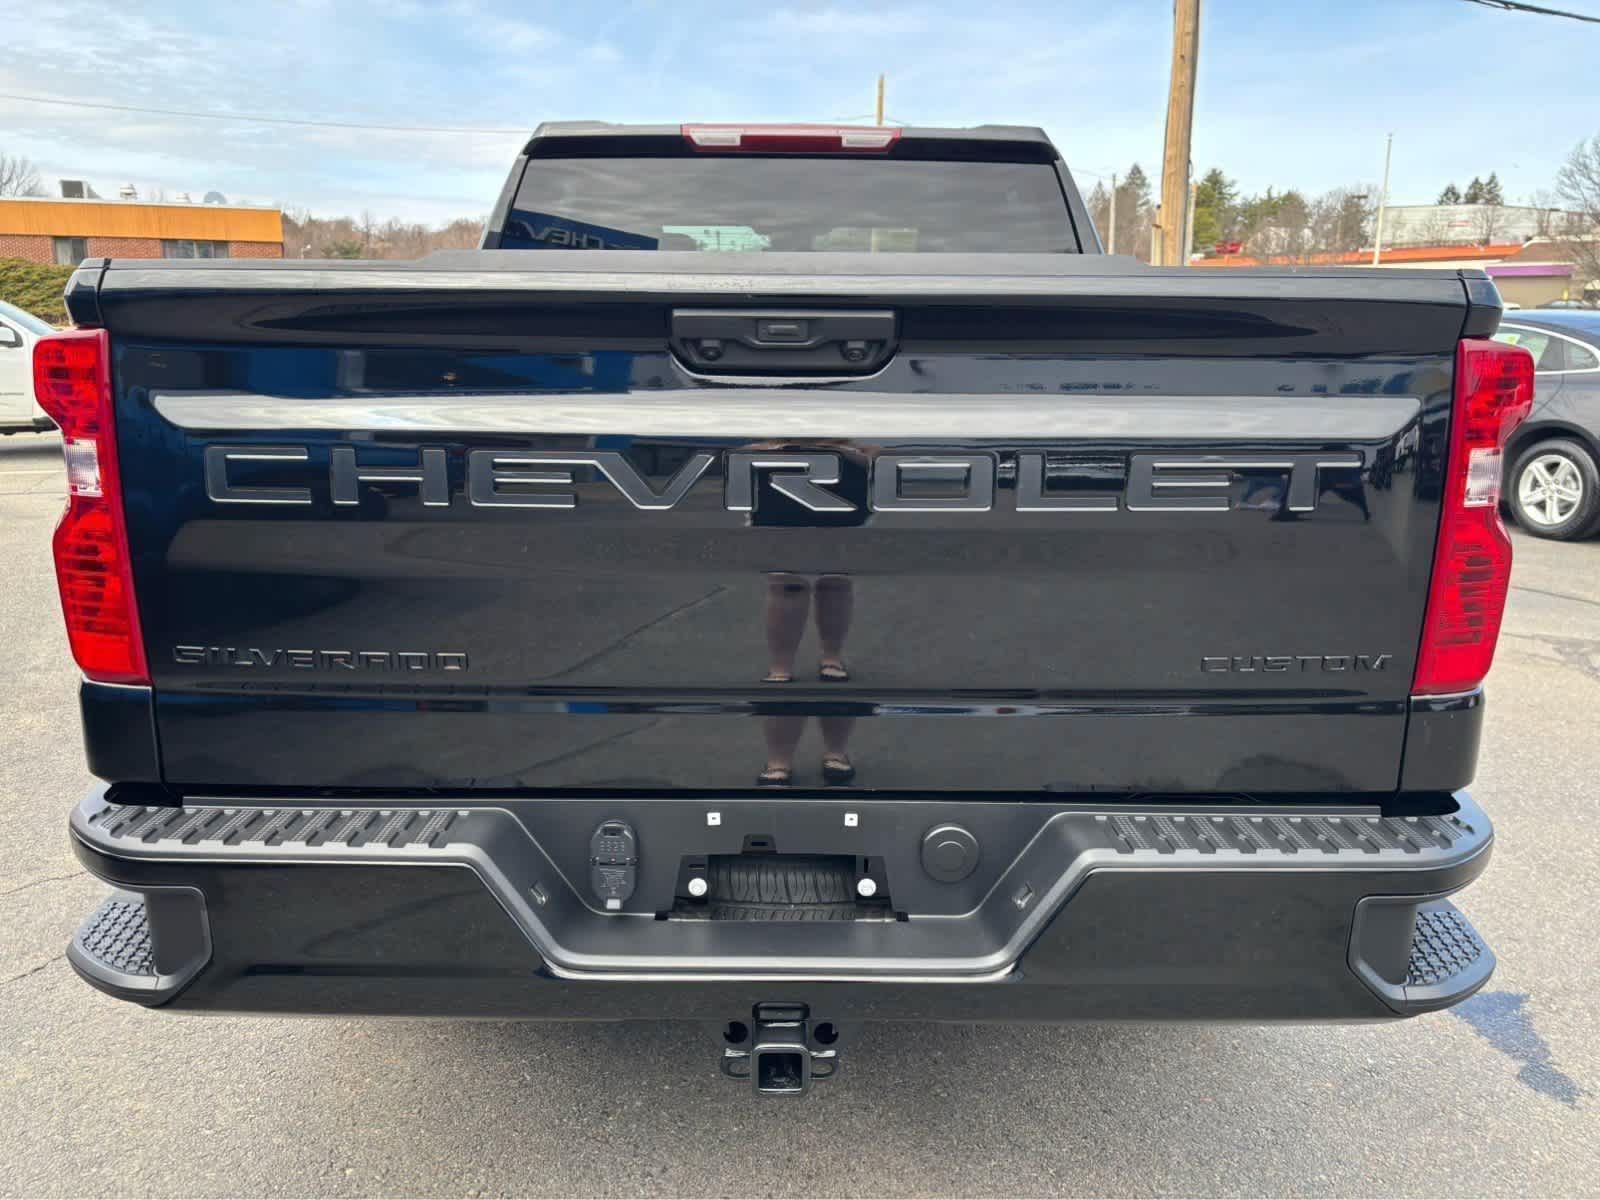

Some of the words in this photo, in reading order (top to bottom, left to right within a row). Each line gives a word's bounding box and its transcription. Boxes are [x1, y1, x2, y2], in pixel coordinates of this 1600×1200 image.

[204, 445, 1363, 513] CHEVROLET
[173, 644, 469, 673] SILVERADO
[1200, 654, 1393, 673] CUSTOM
